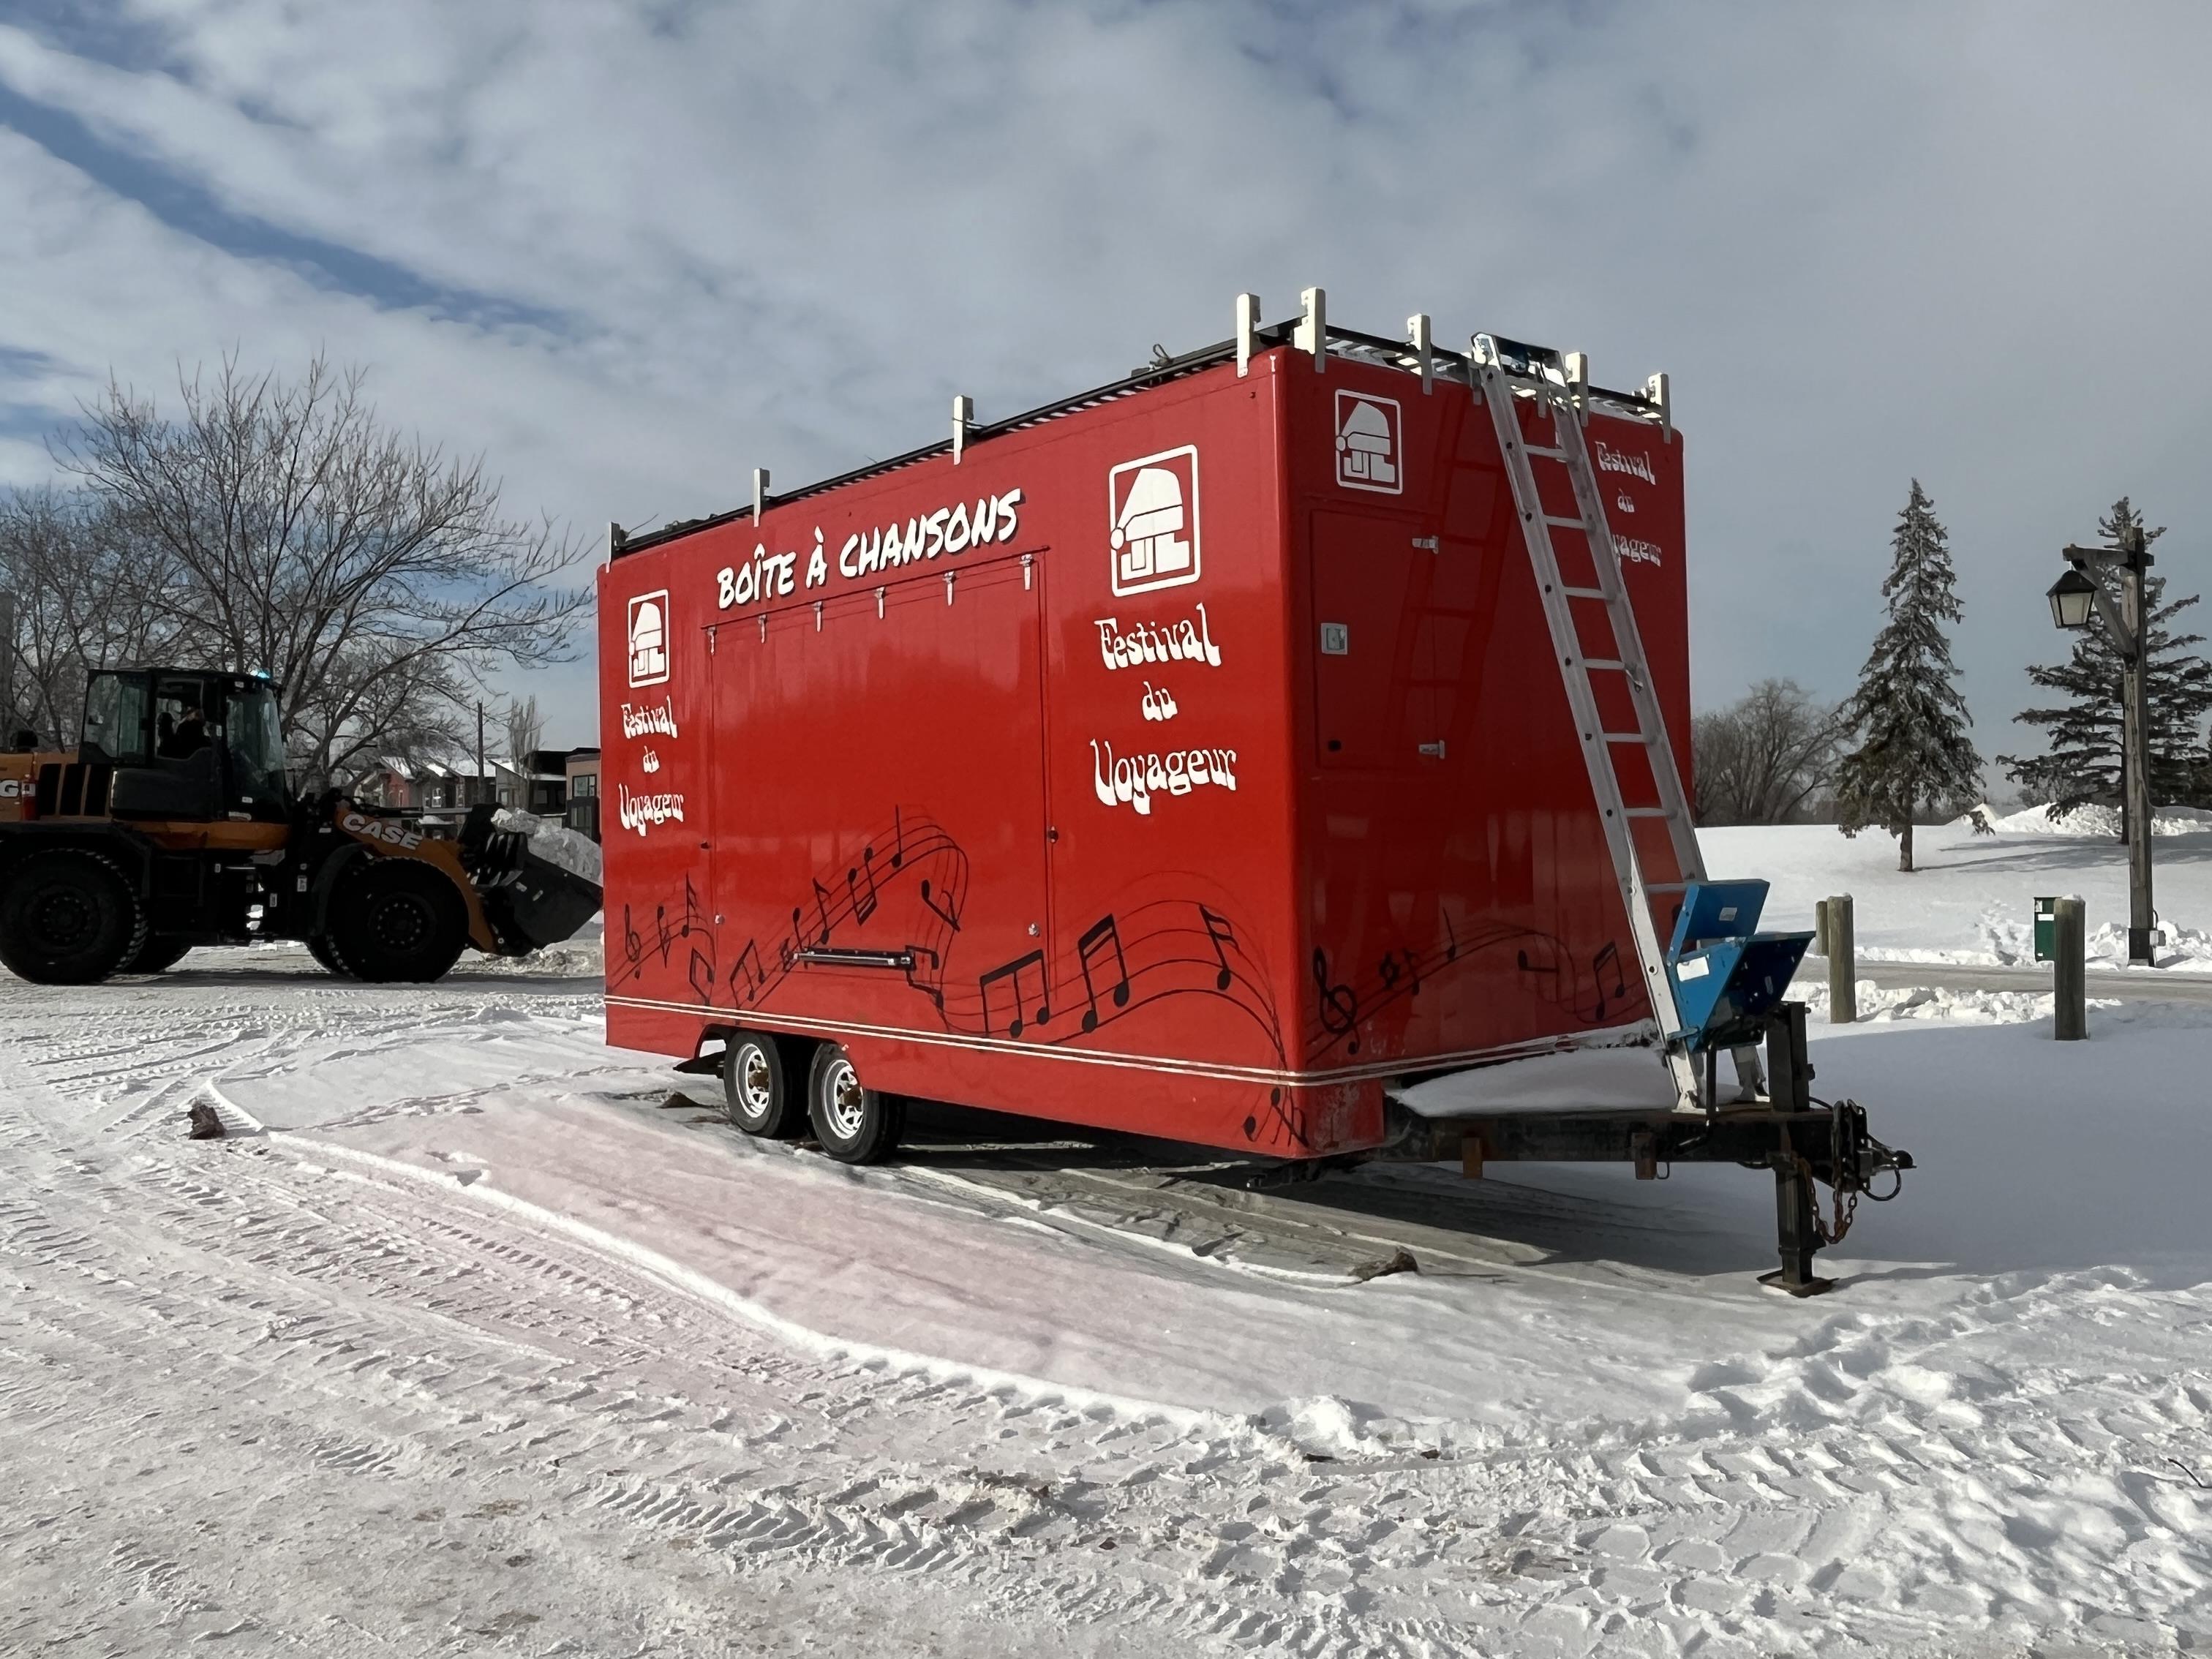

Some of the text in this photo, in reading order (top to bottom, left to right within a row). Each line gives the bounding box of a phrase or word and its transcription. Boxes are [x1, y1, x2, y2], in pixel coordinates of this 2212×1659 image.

[1595, 440, 1657, 486] Festival
[1617, 486, 1636, 513] du
[716, 488, 1023, 610] BOÎTE À CHANSONS
[1094, 602, 1222, 671] Festival
[620, 695, 678, 739] Festival
[1142, 681, 1178, 722] du
[642, 745, 660, 773] du
[1089, 738, 1237, 816] Voyageur
[342, 813, 424, 851] CASE
[618, 782, 684, 837] Voyageur
